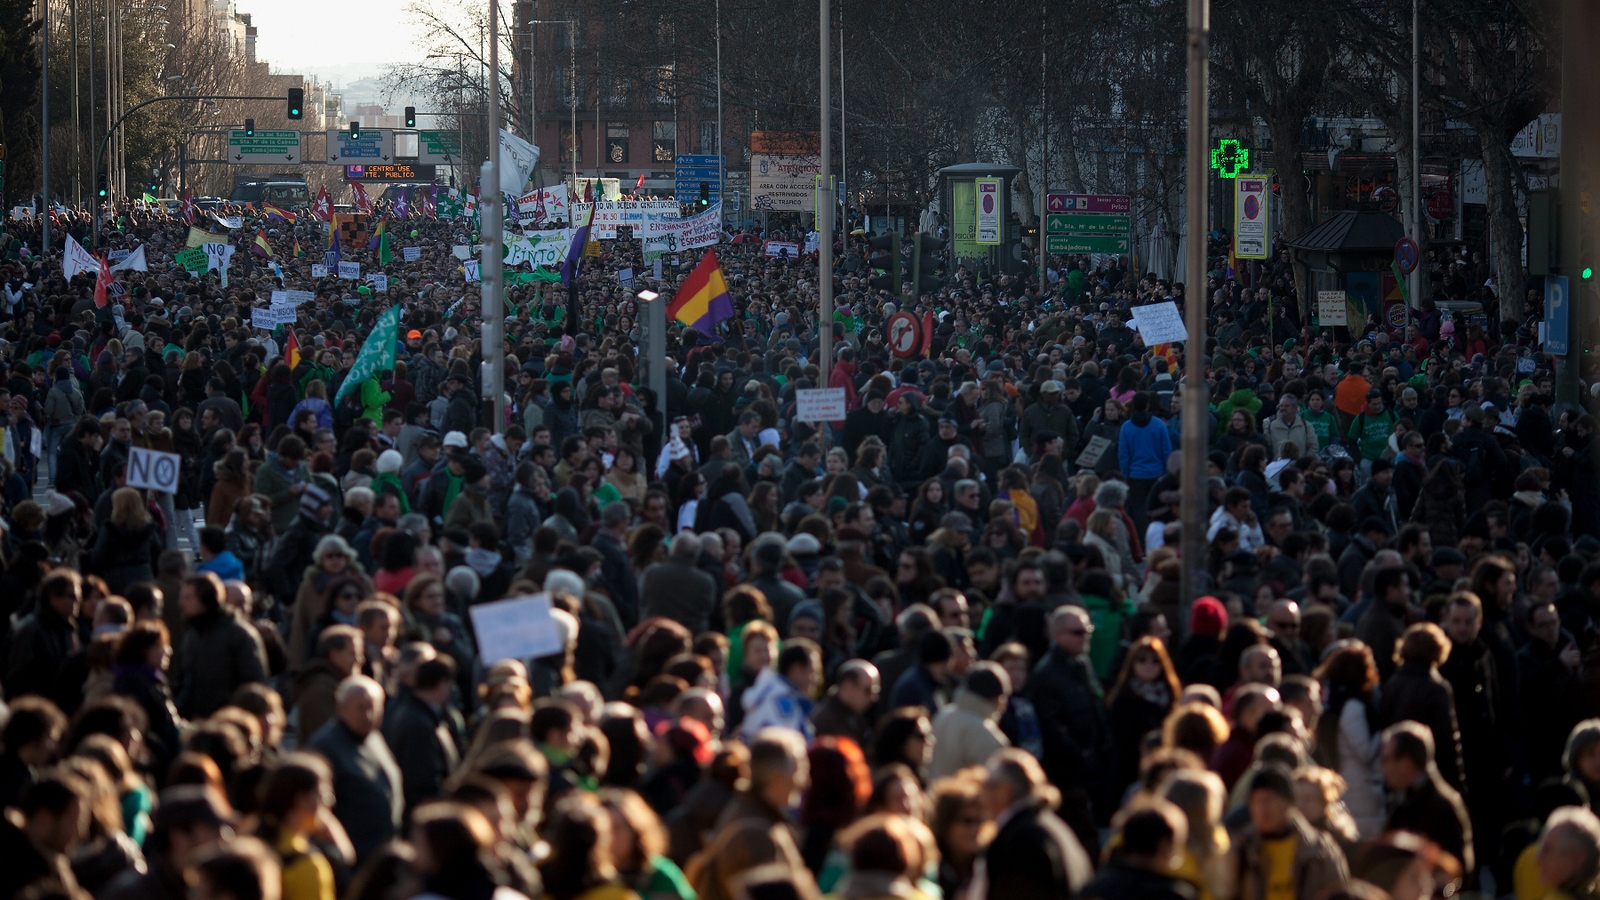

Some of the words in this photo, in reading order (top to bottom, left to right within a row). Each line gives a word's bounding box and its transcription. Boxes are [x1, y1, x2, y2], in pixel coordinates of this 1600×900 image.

[650, 222, 690, 231] ENSEÑANZA
[680, 231, 720, 246] ESPERANZA
[208, 243, 224, 256] NO
[512, 244, 555, 264] PINTO
[1550, 284, 1562, 319] P
[1390, 308, 1405, 317] BURGE
[130, 451, 175, 487] NO
